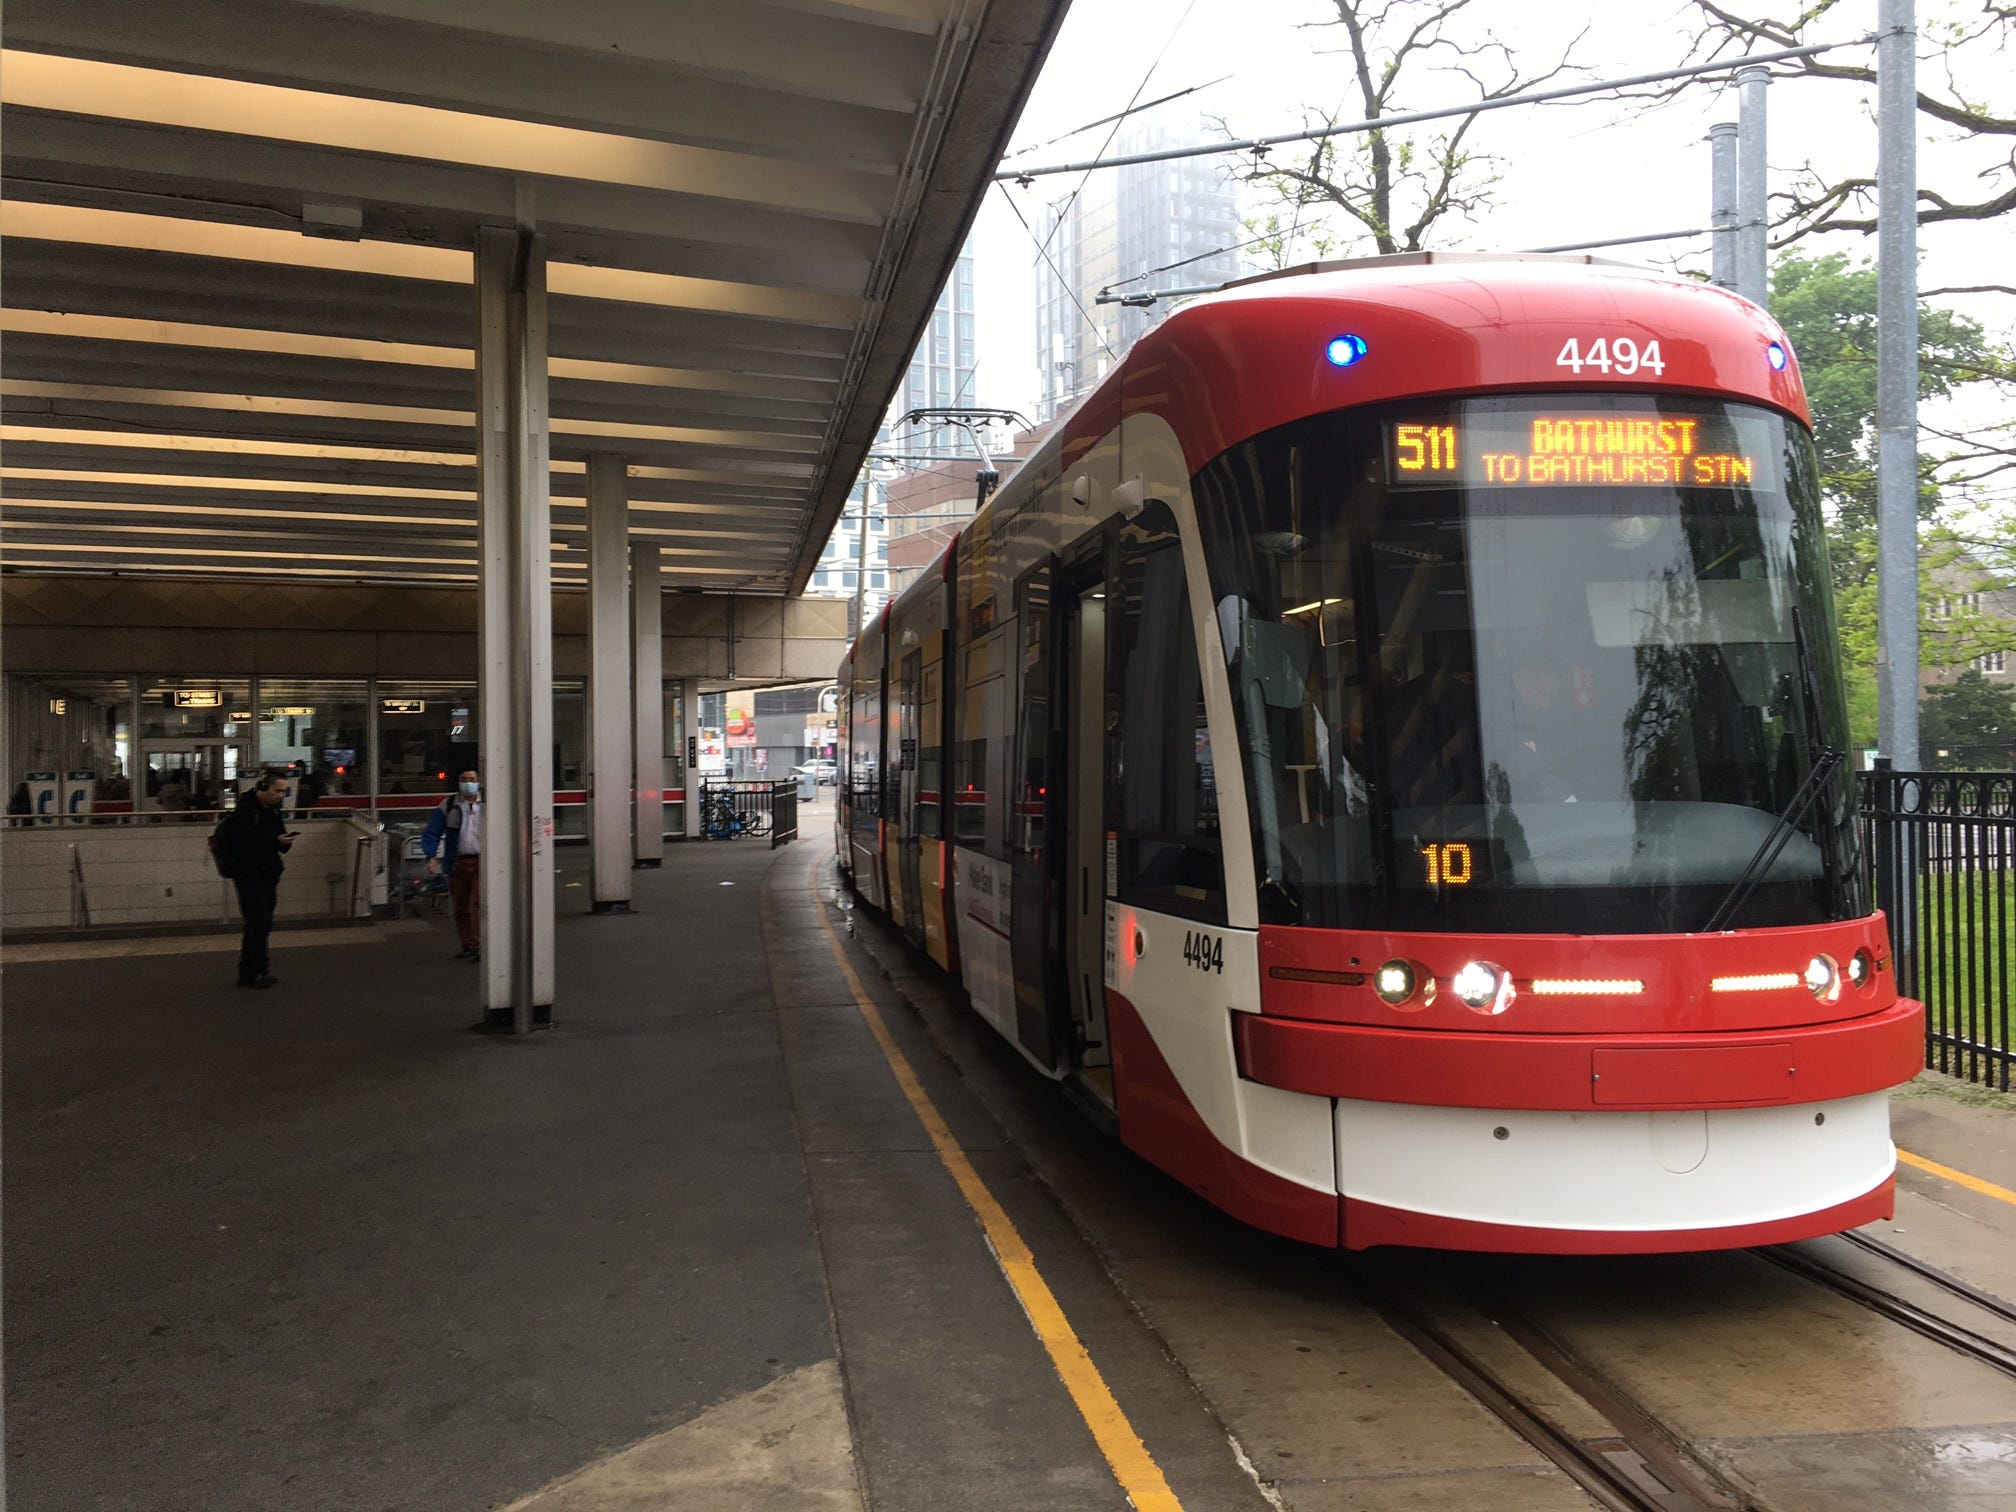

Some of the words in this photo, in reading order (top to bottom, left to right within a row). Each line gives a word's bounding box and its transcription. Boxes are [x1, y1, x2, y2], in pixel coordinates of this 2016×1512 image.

[1556, 337, 1665, 375] 4494
[1397, 425, 1456, 470] 511
[1533, 419, 1696, 455] BATHURST
[1482, 454, 1520, 482] TO
[1528, 455, 1684, 483] BATHURST
[1695, 455, 1753, 483] STN
[1422, 843, 1471, 883] 10
[1183, 930, 1224, 975] 4494
